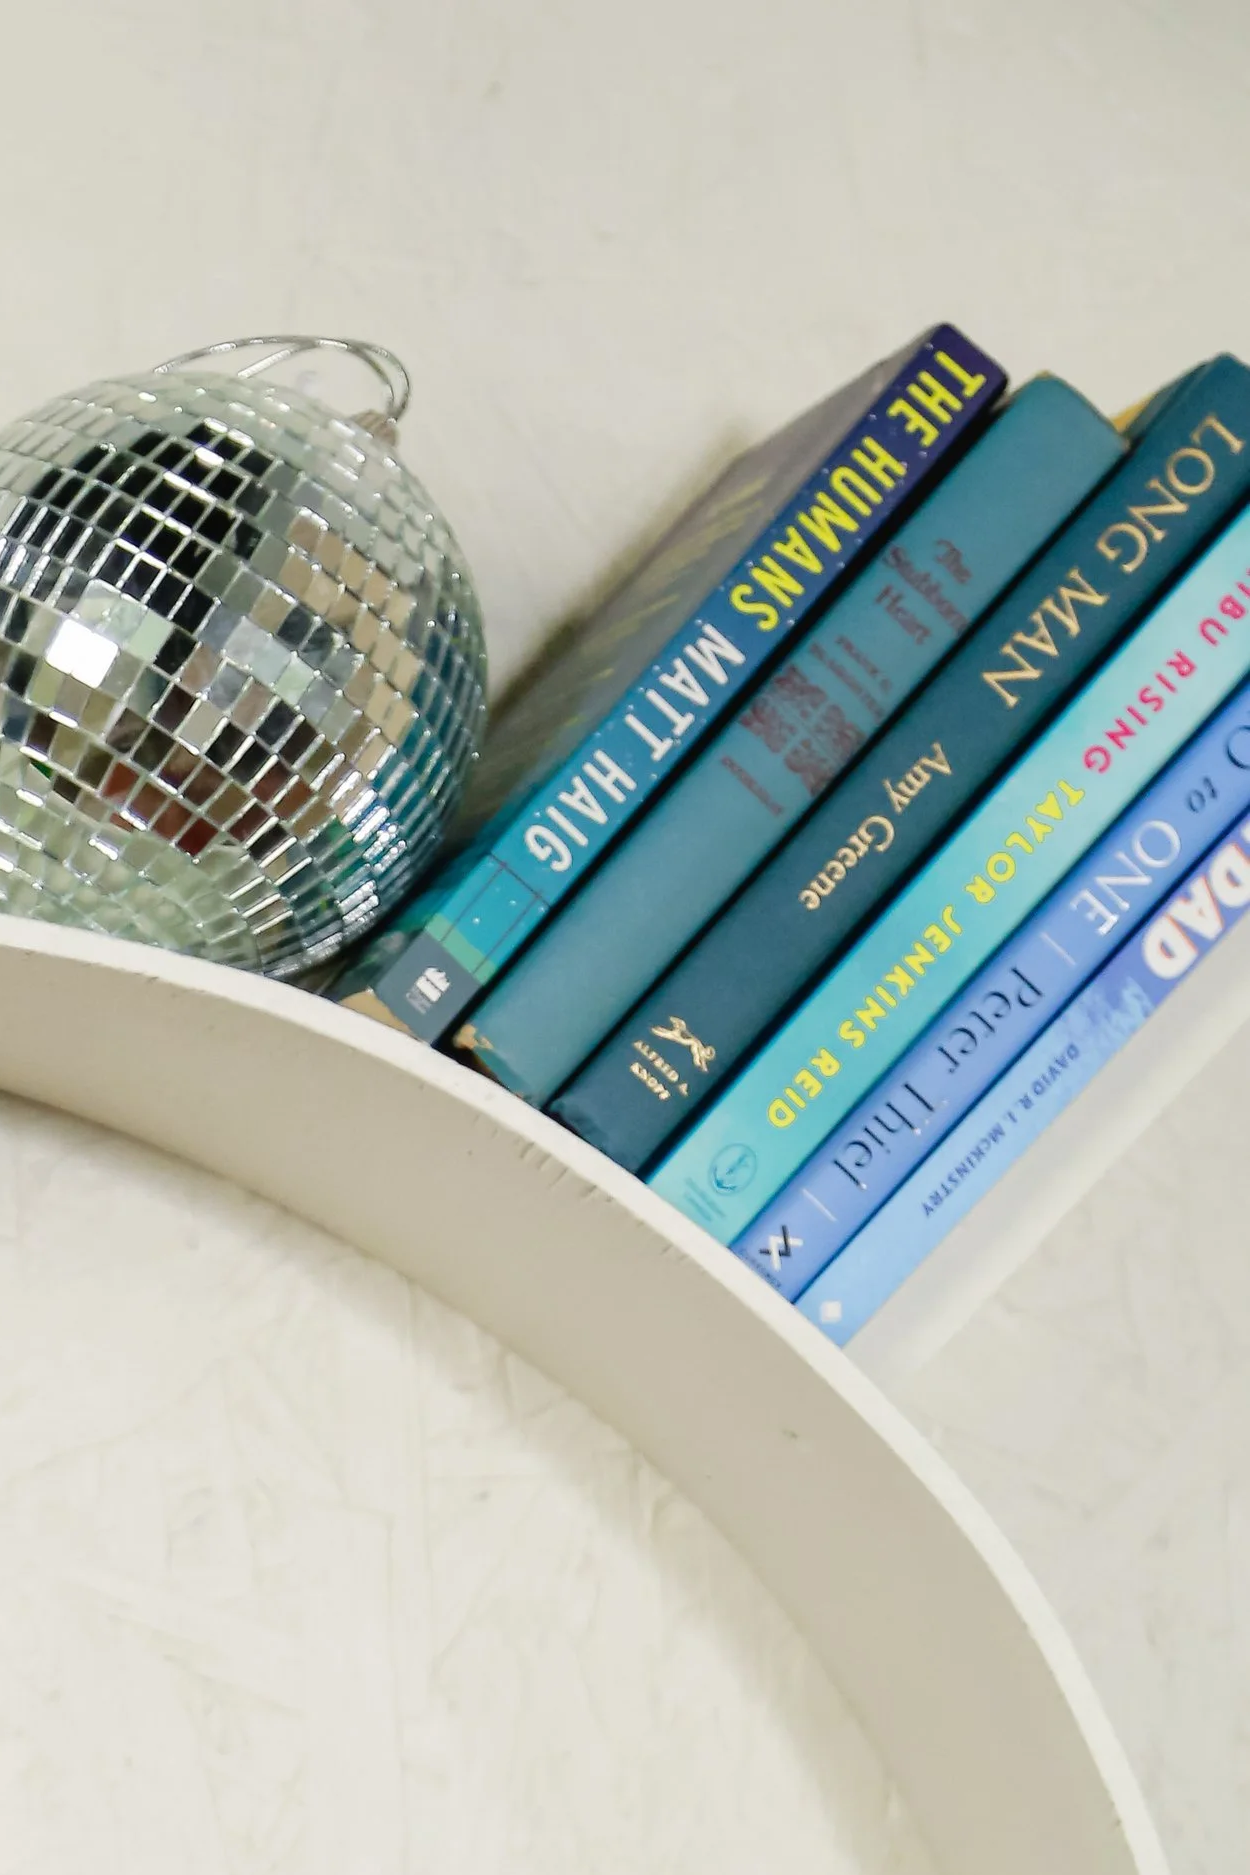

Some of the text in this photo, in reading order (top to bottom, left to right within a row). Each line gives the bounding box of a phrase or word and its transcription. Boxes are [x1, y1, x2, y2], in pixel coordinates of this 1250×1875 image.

[886, 350, 987, 448] THE
[729, 435, 908, 632] HUMANS
[981, 411, 1246, 710] LONG MAN
[624, 622, 746, 762] MATT
[523, 748, 638, 873] HAIG
[766, 568, 1250, 1129] IBU RISING TAYLOR JENKINS REID
[798, 741, 953, 911] Amy Greene
[1187, 776, 1218, 813] to
[1068, 819, 1182, 936] ONE
[1141, 841, 1250, 981] DAD
[833, 966, 1044, 1191] Peter Thiel
[1032, 1043, 1080, 1096] DAVID
